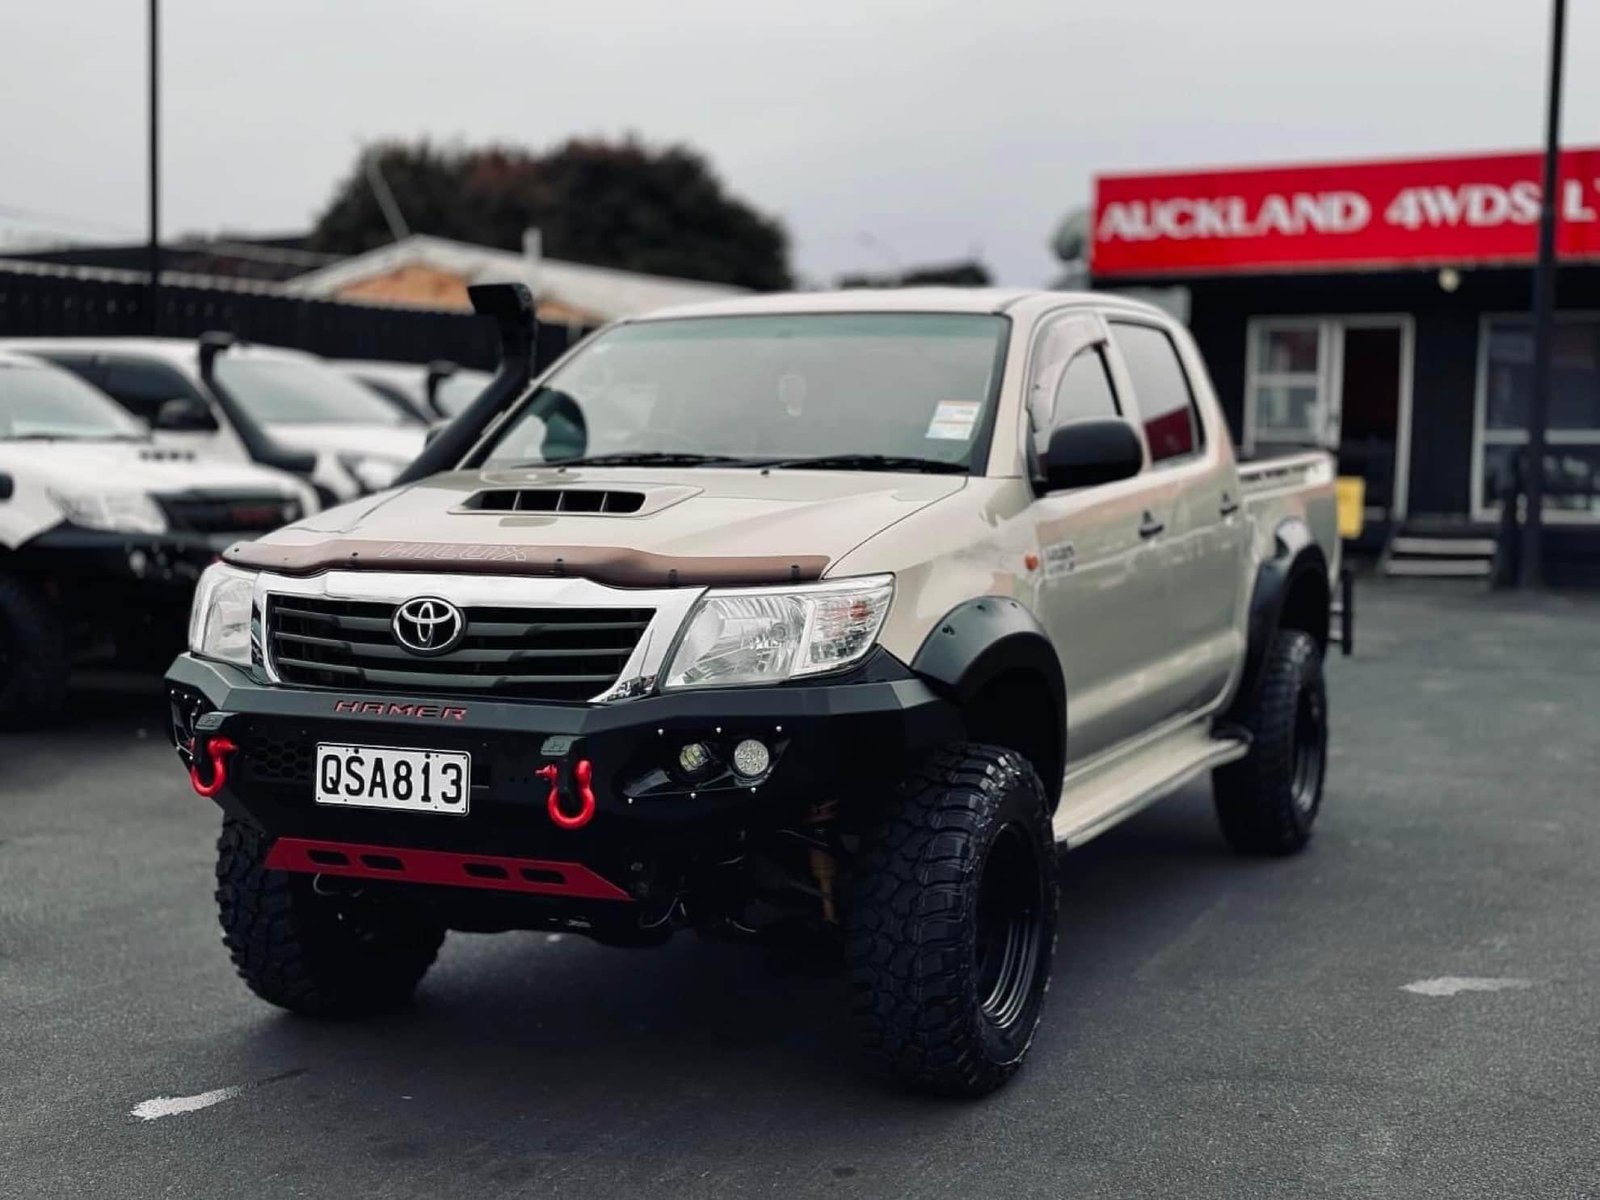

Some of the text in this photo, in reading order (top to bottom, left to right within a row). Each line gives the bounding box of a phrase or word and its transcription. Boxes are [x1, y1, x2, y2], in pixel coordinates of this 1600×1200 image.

[1098, 177, 1600, 242] AUCKLAND 4WDS L
[379, 542, 526, 562] HILUX
[334, 700, 468, 721] HAMER
[321, 754, 463, 805] QSA813
